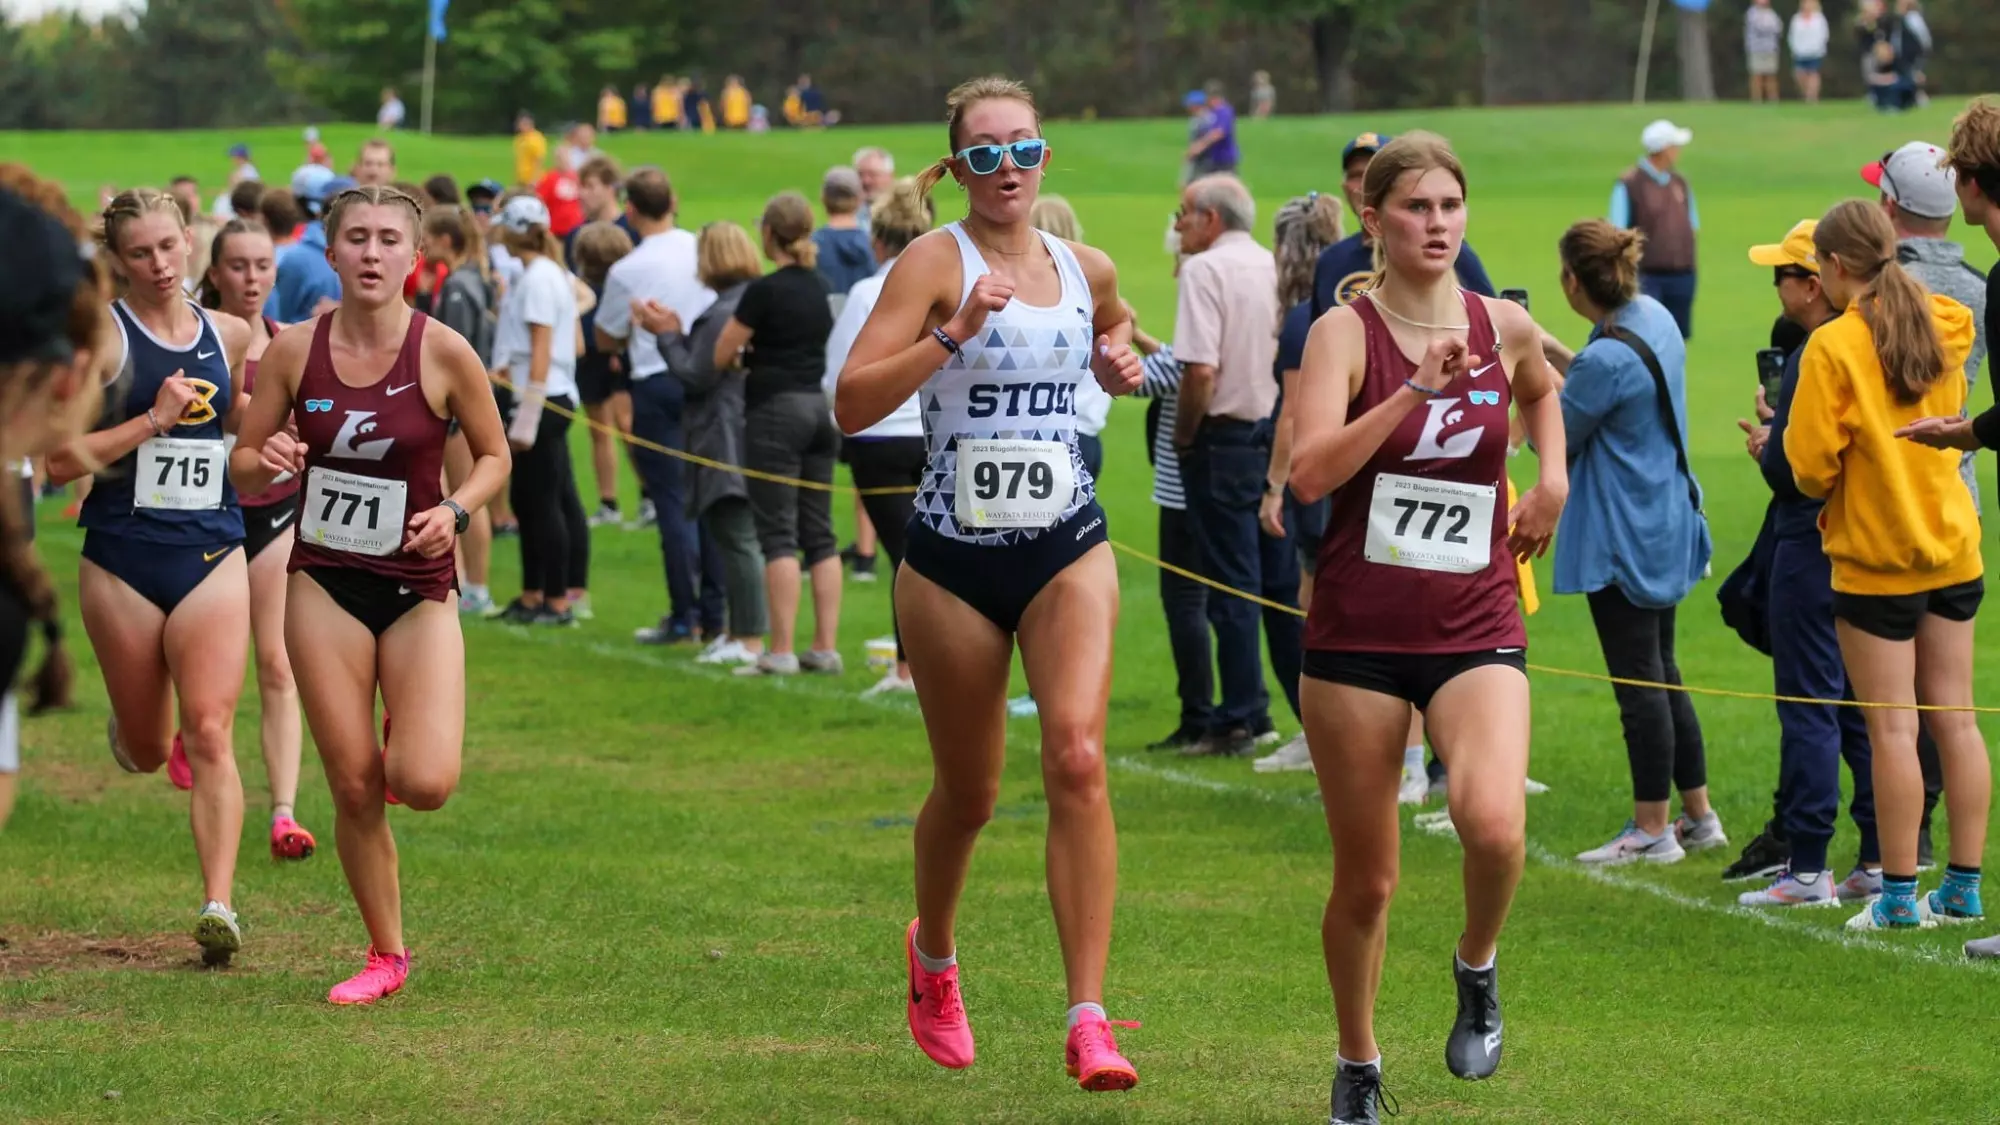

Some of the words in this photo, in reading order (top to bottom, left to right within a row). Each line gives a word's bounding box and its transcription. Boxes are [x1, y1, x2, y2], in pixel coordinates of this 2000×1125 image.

[972, 445, 988, 453] 2023
[154, 456, 210, 487] 715
[974, 461, 1054, 500] 979
[1394, 481, 1411, 489] 2023
[321, 487, 381, 530] 771
[985, 511, 1021, 519] WAYZATA
[1394, 497, 1471, 544] 772
